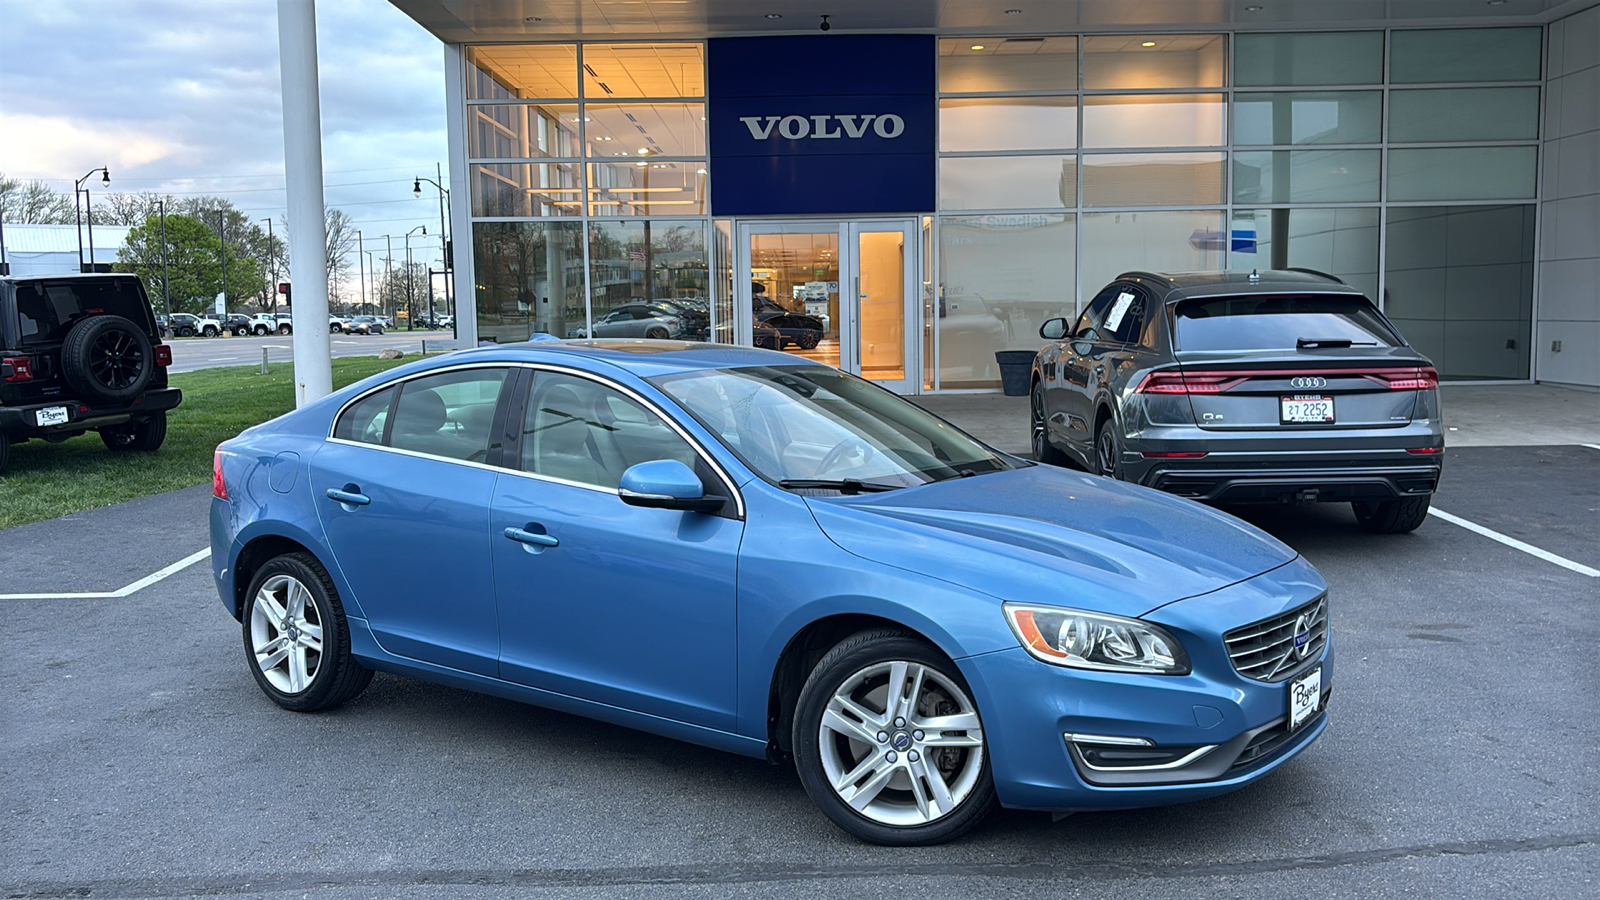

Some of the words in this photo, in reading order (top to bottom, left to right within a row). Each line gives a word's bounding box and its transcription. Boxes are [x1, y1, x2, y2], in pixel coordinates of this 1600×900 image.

[739, 113, 905, 140] VOLVO
[986, 214, 1048, 229] Swedish
[1288, 404, 1300, 415] 27
[1303, 402, 1328, 417] 2252
[1293, 682, 1318, 706] Byers
